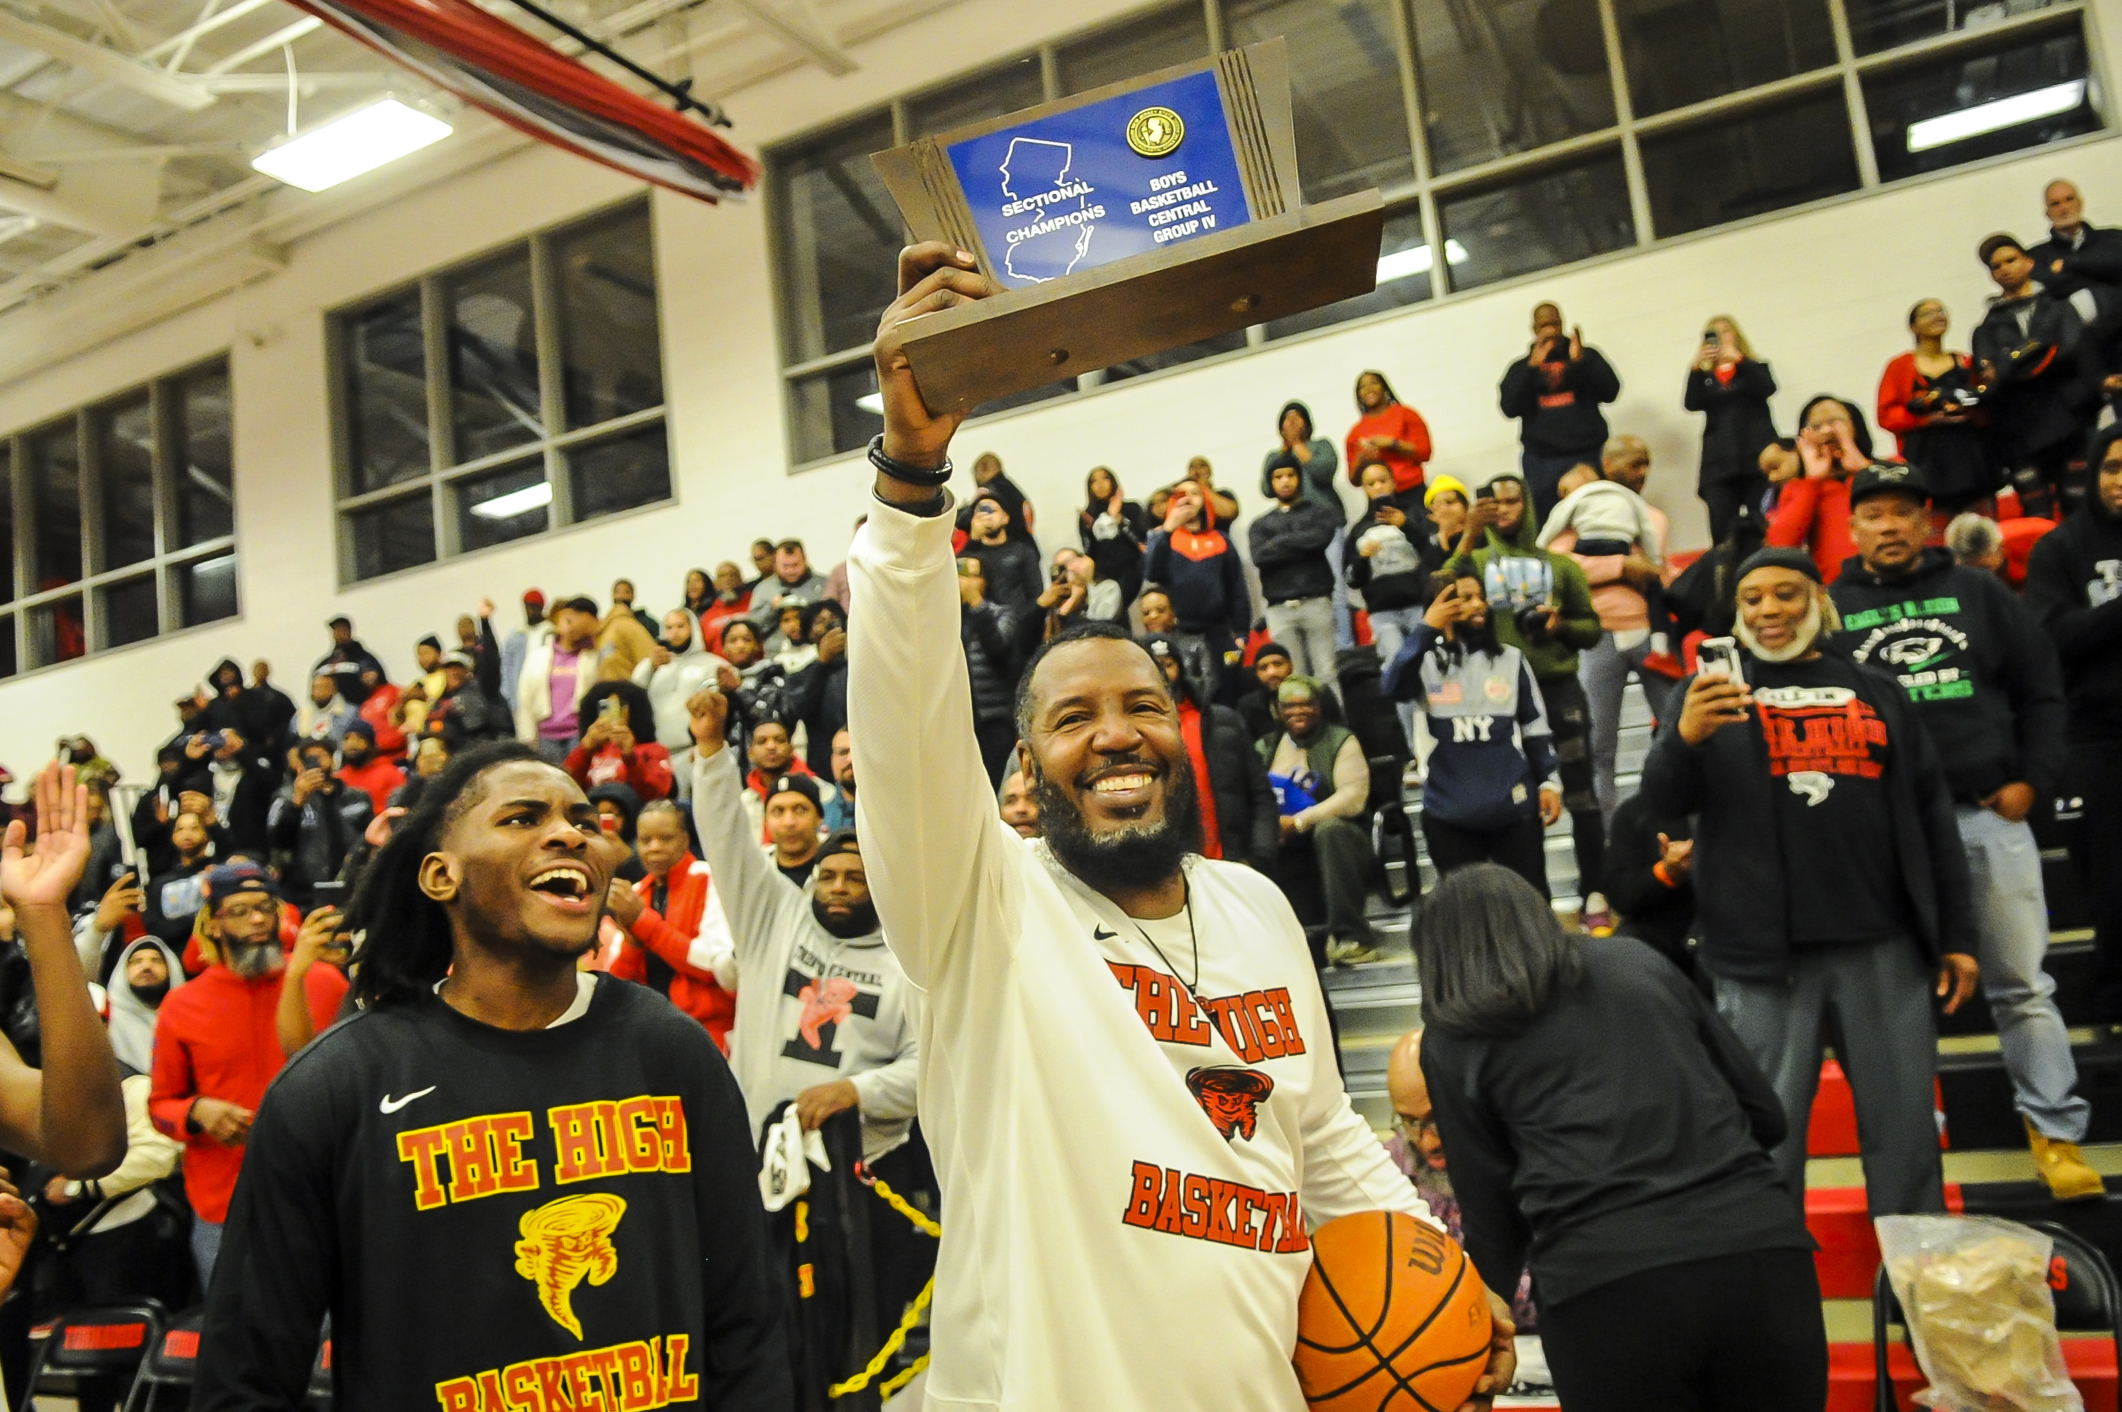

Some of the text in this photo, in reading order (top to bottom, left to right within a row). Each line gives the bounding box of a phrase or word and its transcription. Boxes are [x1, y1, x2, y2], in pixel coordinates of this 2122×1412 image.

[1149, 170, 1188, 192] BOYS
[1001, 181, 1095, 218] SECTIONAL
[1129, 180, 1219, 216] BASKETBALL
[1148, 199, 1212, 227] CENTRAL
[1005, 203, 1106, 243] CHAMPIONS
[1153, 214, 1217, 244] GROUP IV
[1451, 714, 1494, 743] NY
[396, 1110, 540, 1211] THE
[547, 1094, 692, 1185] HIGH
